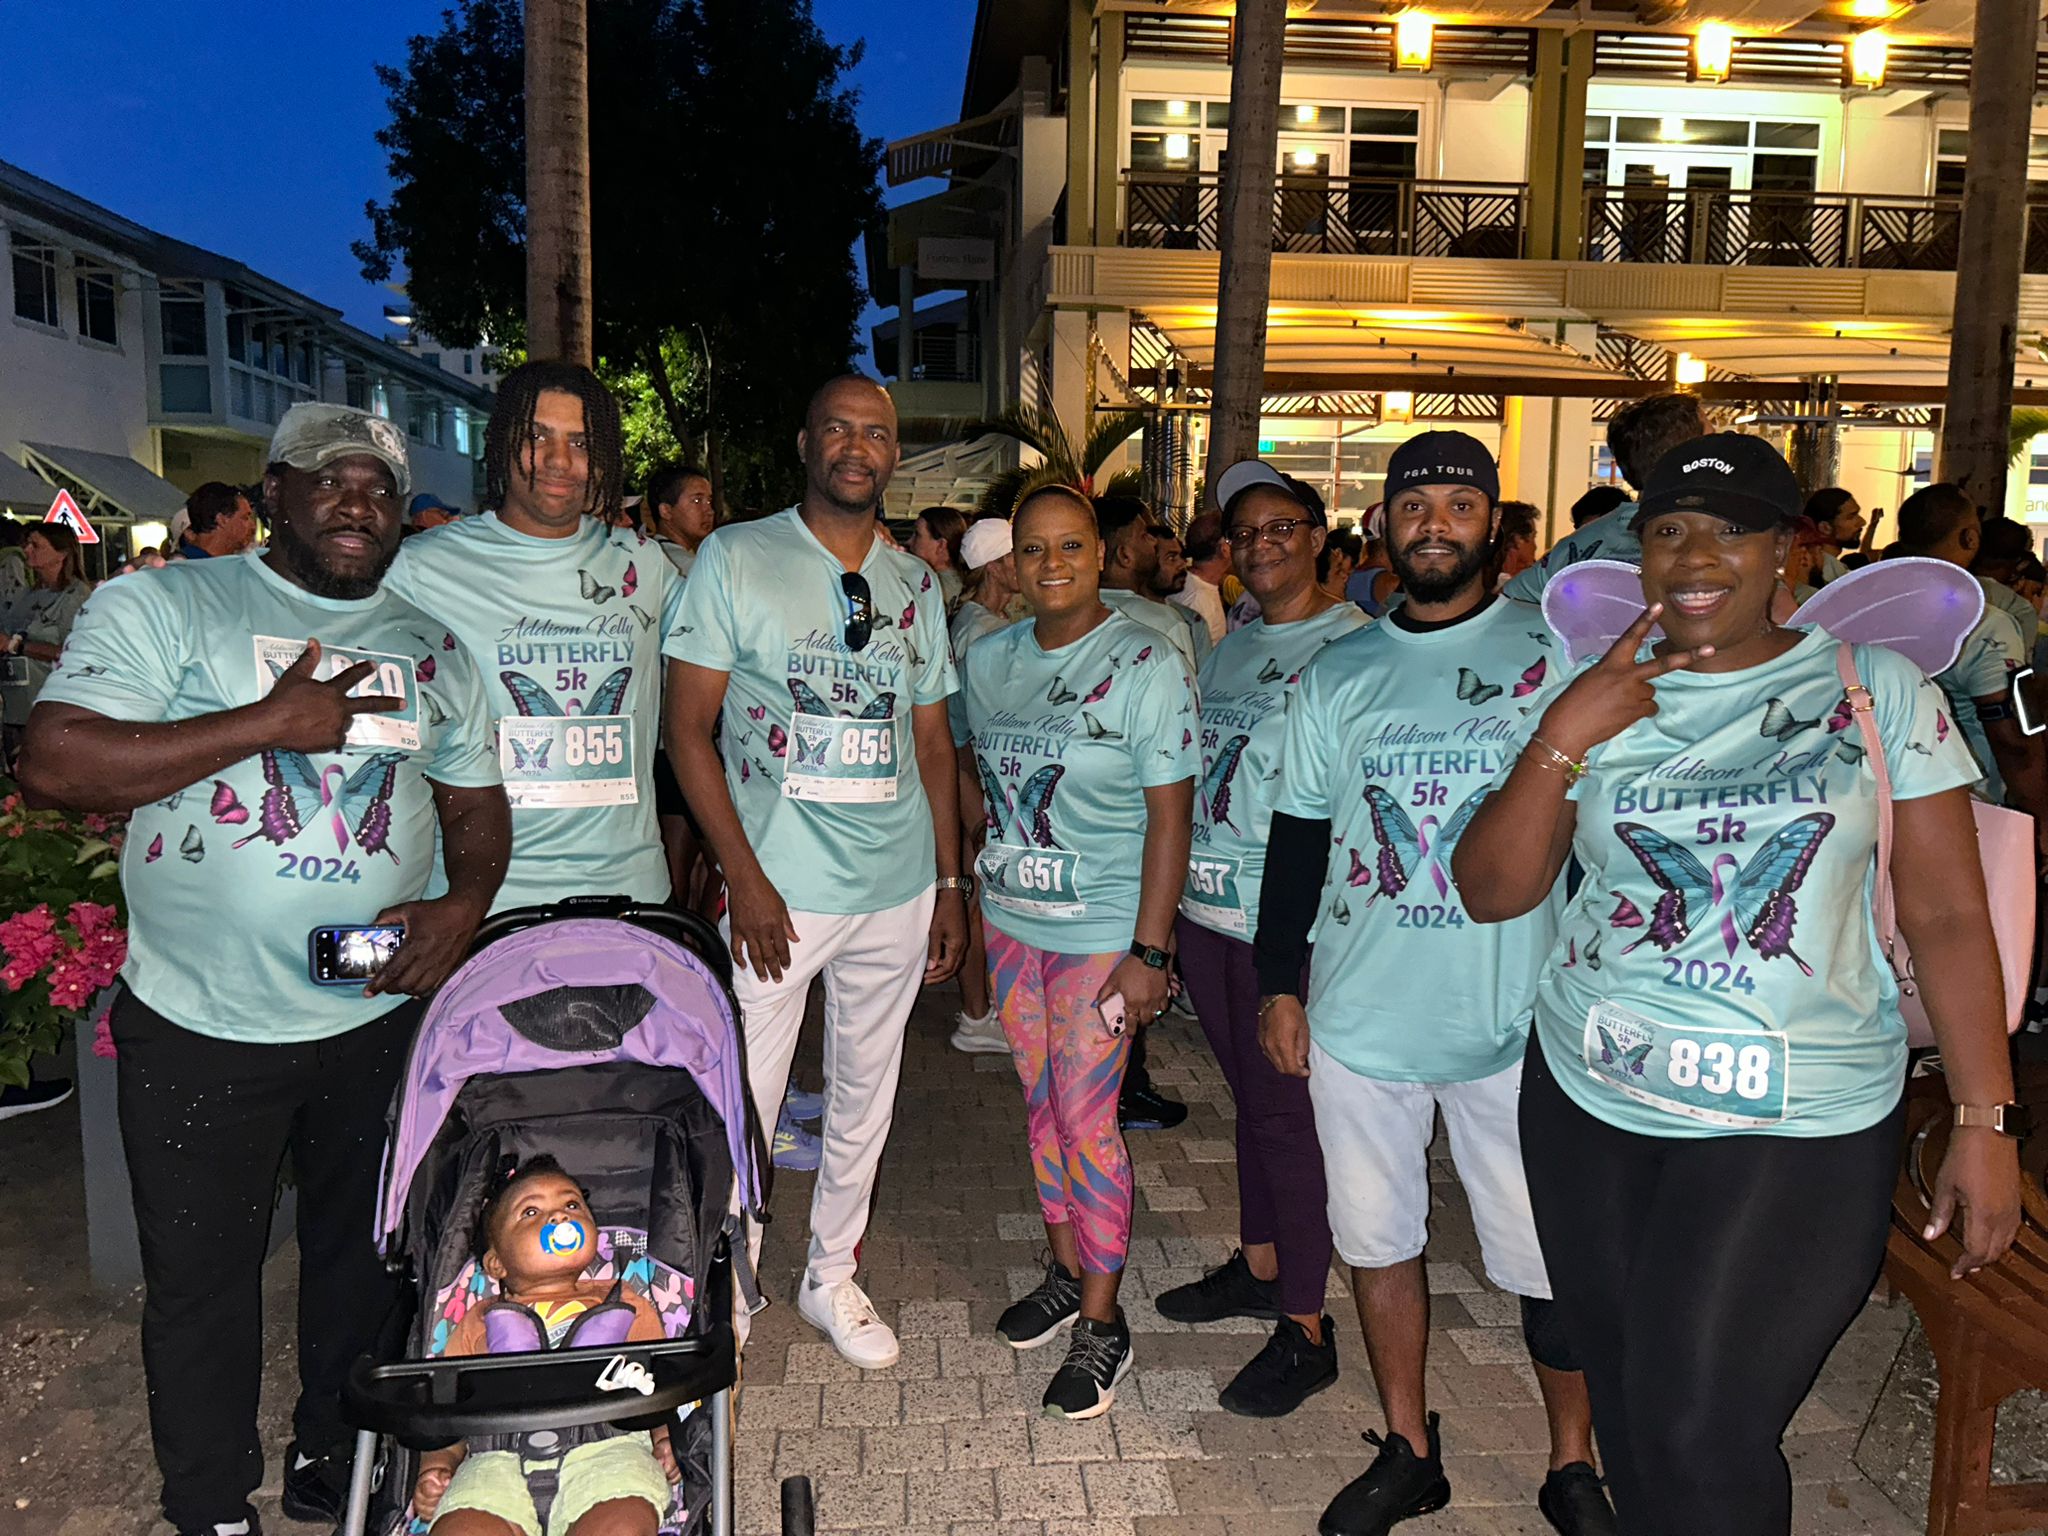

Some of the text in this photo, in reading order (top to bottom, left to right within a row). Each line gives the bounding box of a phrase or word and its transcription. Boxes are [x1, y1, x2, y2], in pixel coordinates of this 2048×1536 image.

[1403, 465, 1474, 479] PGA TOUR
[1682, 457, 1736, 475] BOSTON
[495, 613, 634, 643] Addison Kelly
[497, 641, 635, 666] BUTTERFLY
[867, 640, 905, 665] Kelly
[555, 667, 588, 692] 5k
[787, 652, 900, 688] BUTTERFLY
[830, 682, 858, 704] 5k
[982, 710, 1077, 741] Addison Kelly
[1201, 728, 1219, 749] 5k
[1360, 716, 1517, 755] Addison Kelly
[401, 737, 418, 747] 820
[565, 725, 623, 766] 855
[840, 728, 892, 765] 859
[978, 731, 1070, 760] BUTTERFLY
[999, 756, 1022, 777] 5k
[1410, 778, 1448, 807] 5k
[1614, 776, 1829, 815] BUTTERFLY
[1695, 813, 1747, 846] 5k
[275, 852, 361, 885] 2024
[1017, 854, 1064, 892] 651
[1188, 859, 1231, 896] 657
[1396, 904, 1465, 930] 2024
[1662, 957, 1756, 996] 2024
[1597, 1014, 1655, 1044] BUTTERFLY
[1667, 1038, 1771, 1100] 838
